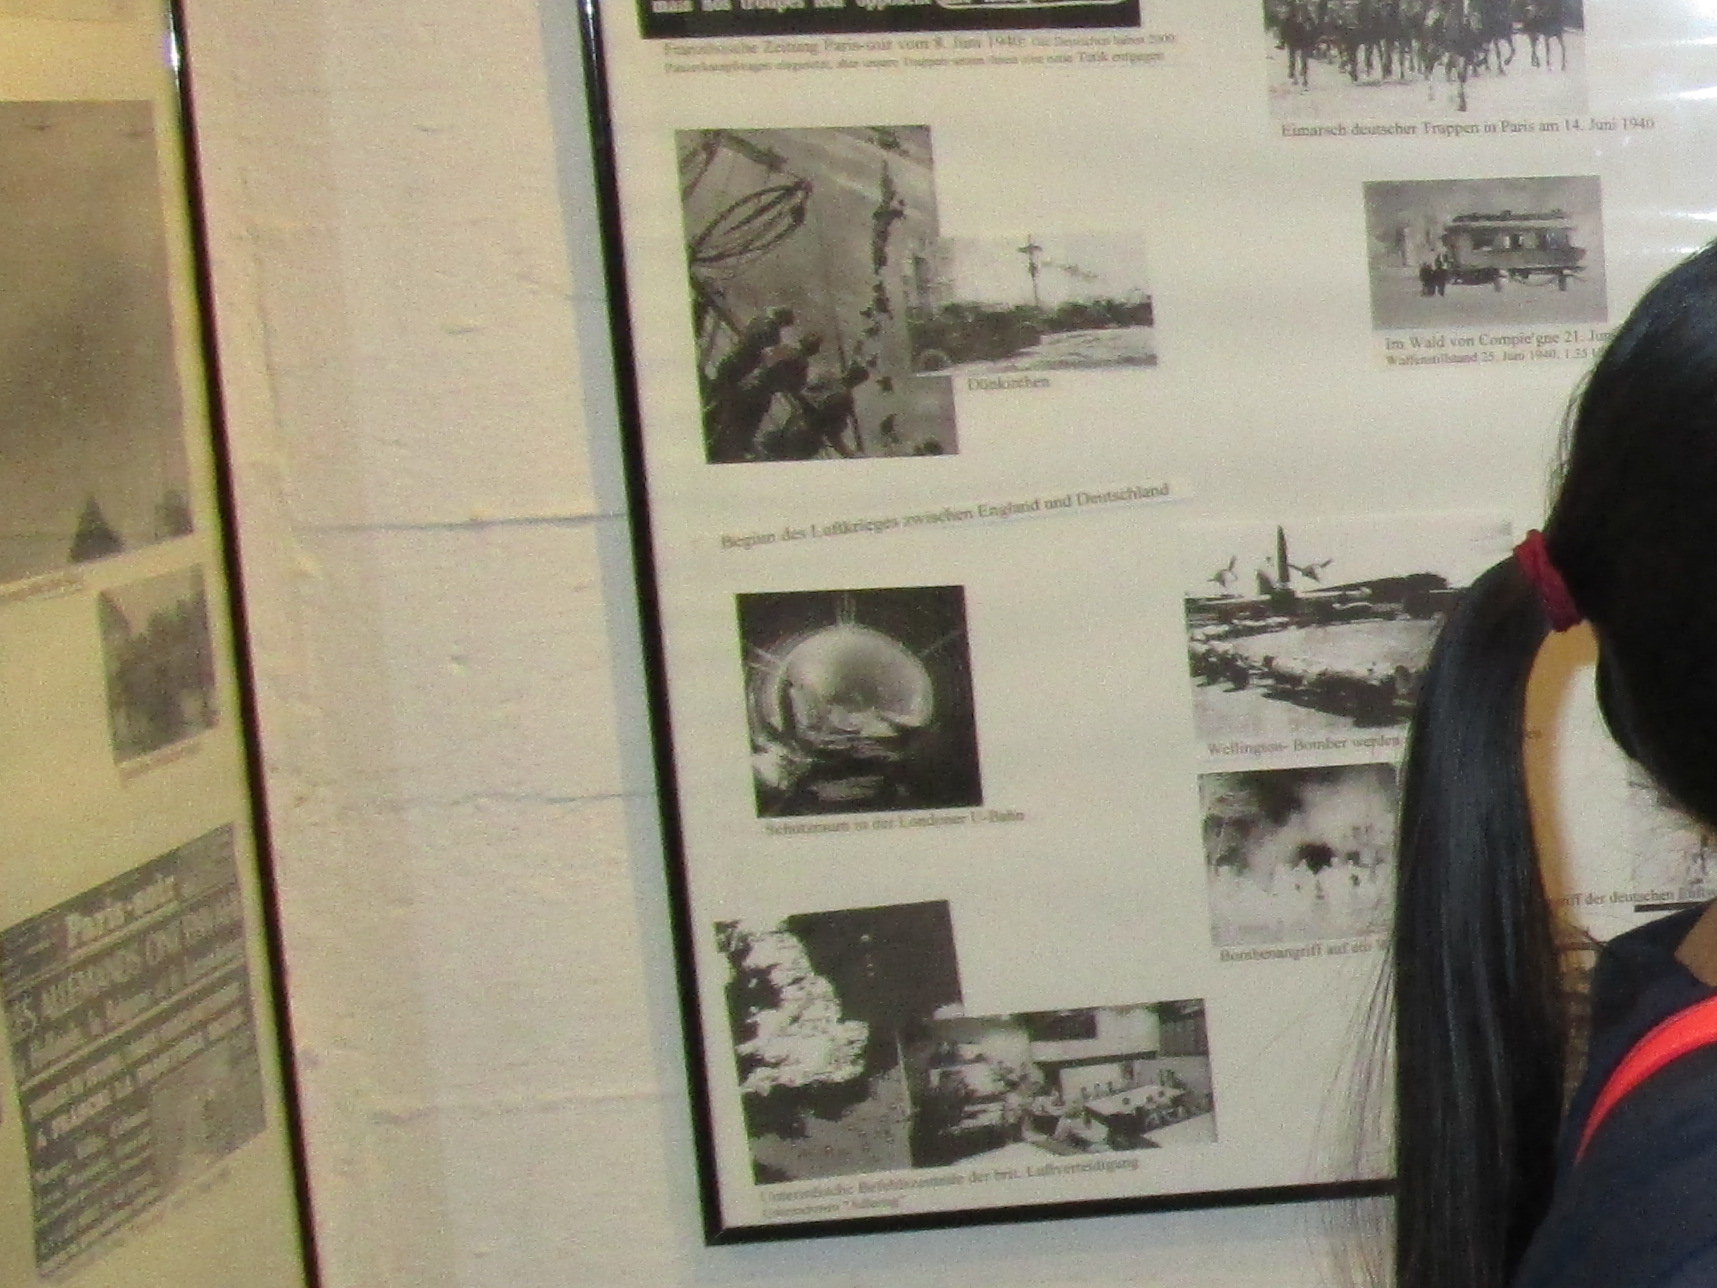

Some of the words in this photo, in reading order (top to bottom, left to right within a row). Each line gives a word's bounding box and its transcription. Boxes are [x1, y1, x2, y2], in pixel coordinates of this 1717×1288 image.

[1352, 122, 1416, 135] deutscher
[1501, 120, 1535, 132] Paris
[1539, 123, 1558, 131] am
[1622, 117, 1654, 129] 1940
[1451, 336, 1474, 347] von
[782, 526, 806, 541] des
[1045, 495, 1071, 510] und
[1294, 738, 1346, 750] Bomber
